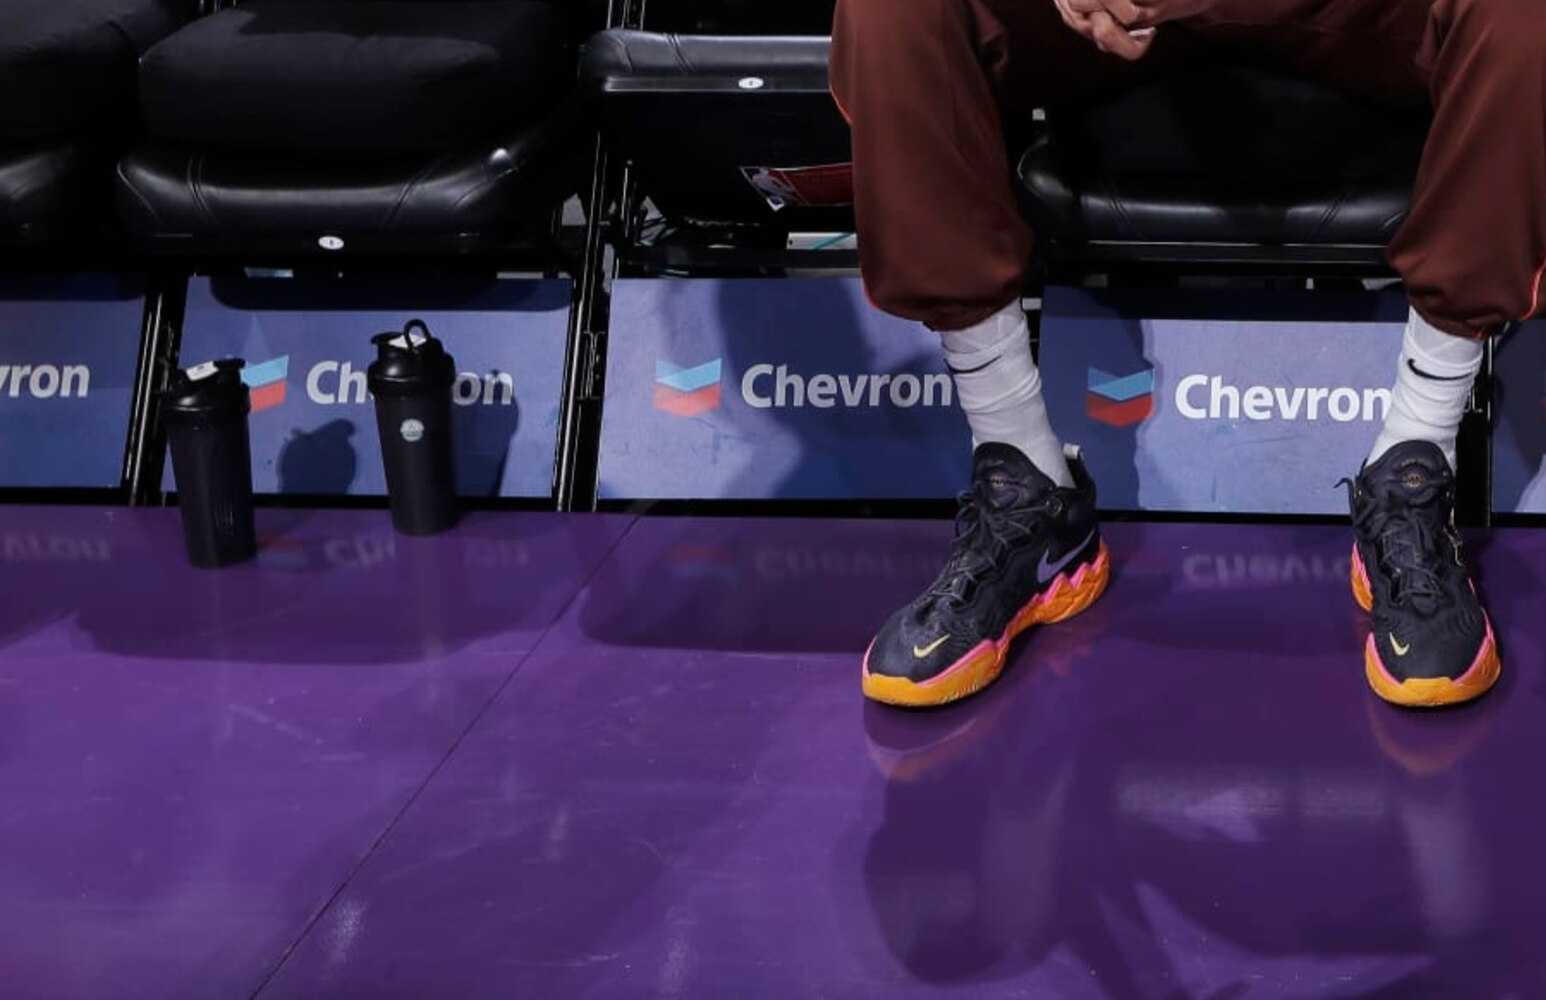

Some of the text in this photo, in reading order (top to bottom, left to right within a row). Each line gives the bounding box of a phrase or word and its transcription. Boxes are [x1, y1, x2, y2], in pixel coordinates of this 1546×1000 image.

[306, 360, 513, 406] Chon
[741, 363, 953, 408] Chevron
[1175, 374, 1392, 422] Chevron
